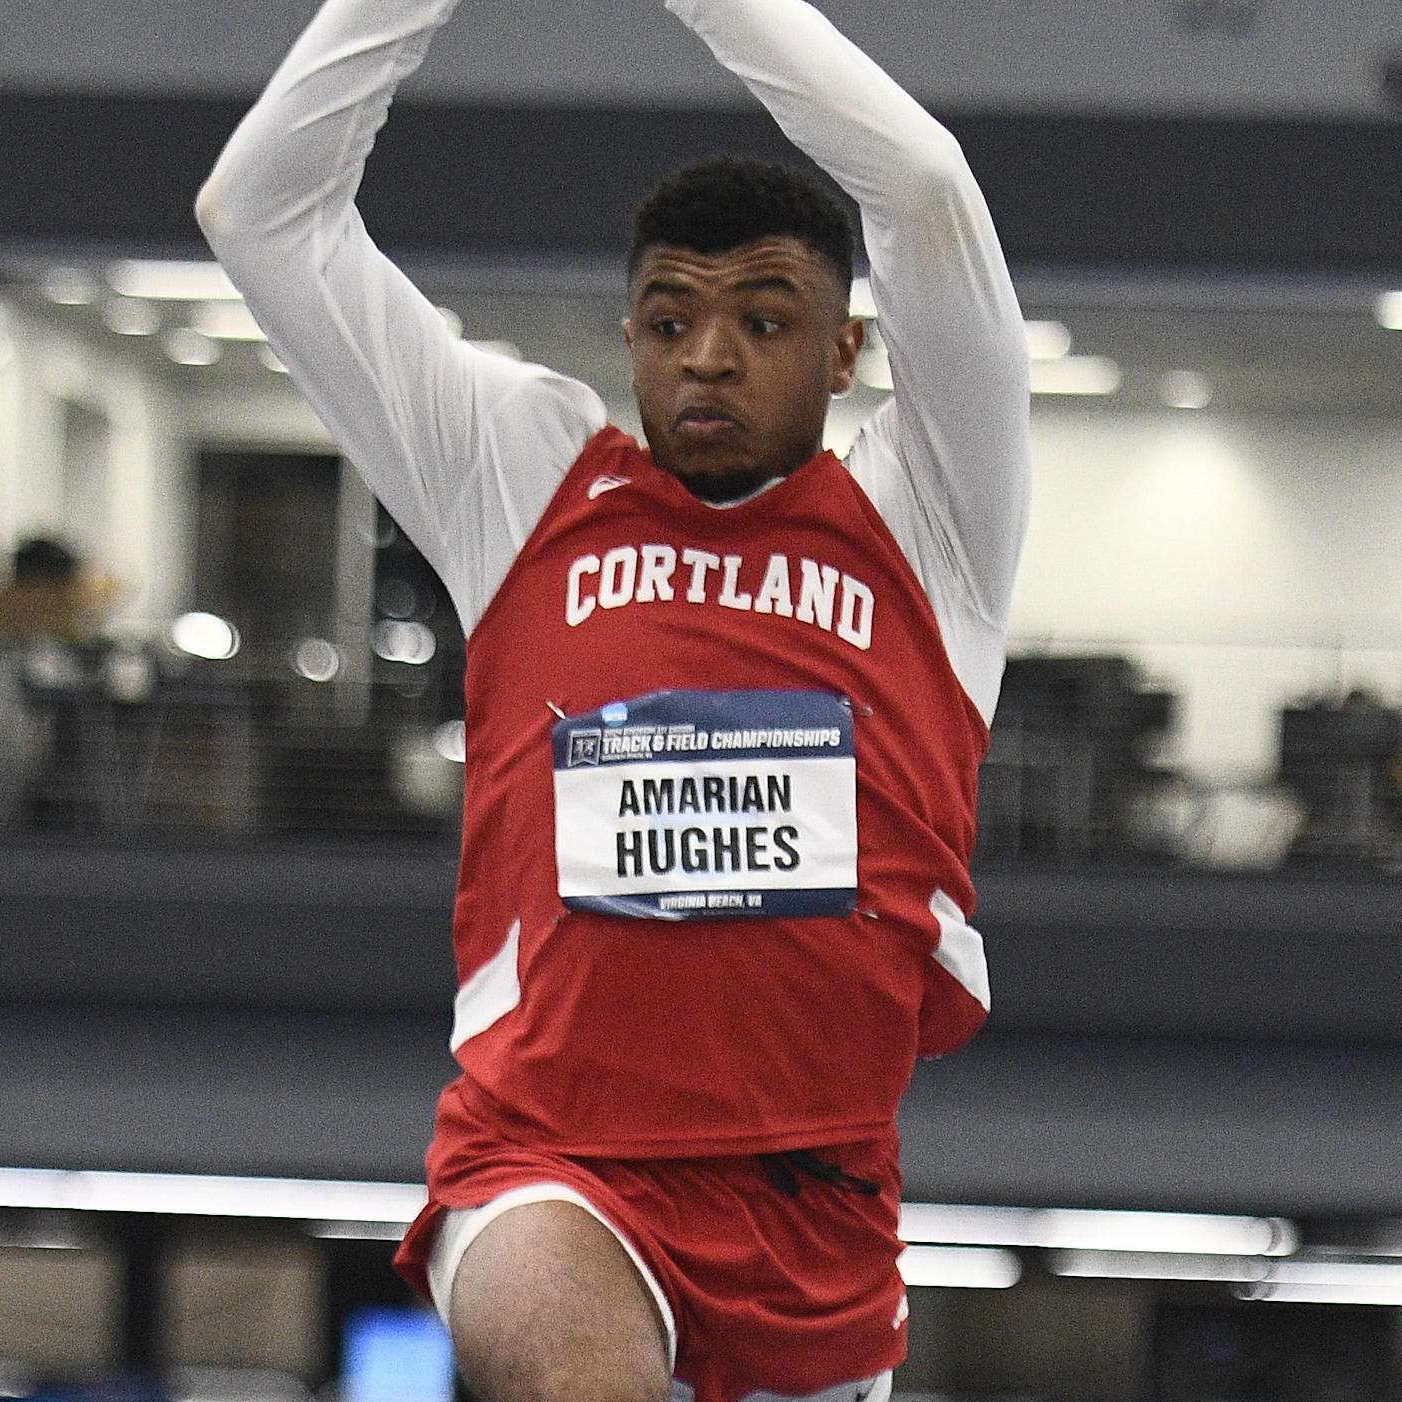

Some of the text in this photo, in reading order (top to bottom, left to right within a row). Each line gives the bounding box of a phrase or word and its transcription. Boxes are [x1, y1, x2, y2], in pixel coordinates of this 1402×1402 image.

[565, 544, 876, 651] CORTLAND
[602, 734, 651, 756] TRACK
[666, 731, 709, 752] FIELD
[711, 727, 841, 750] CHAMPIONSHIPS
[618, 774, 792, 818] AMARIAN
[615, 825, 801, 878] HUGHES
